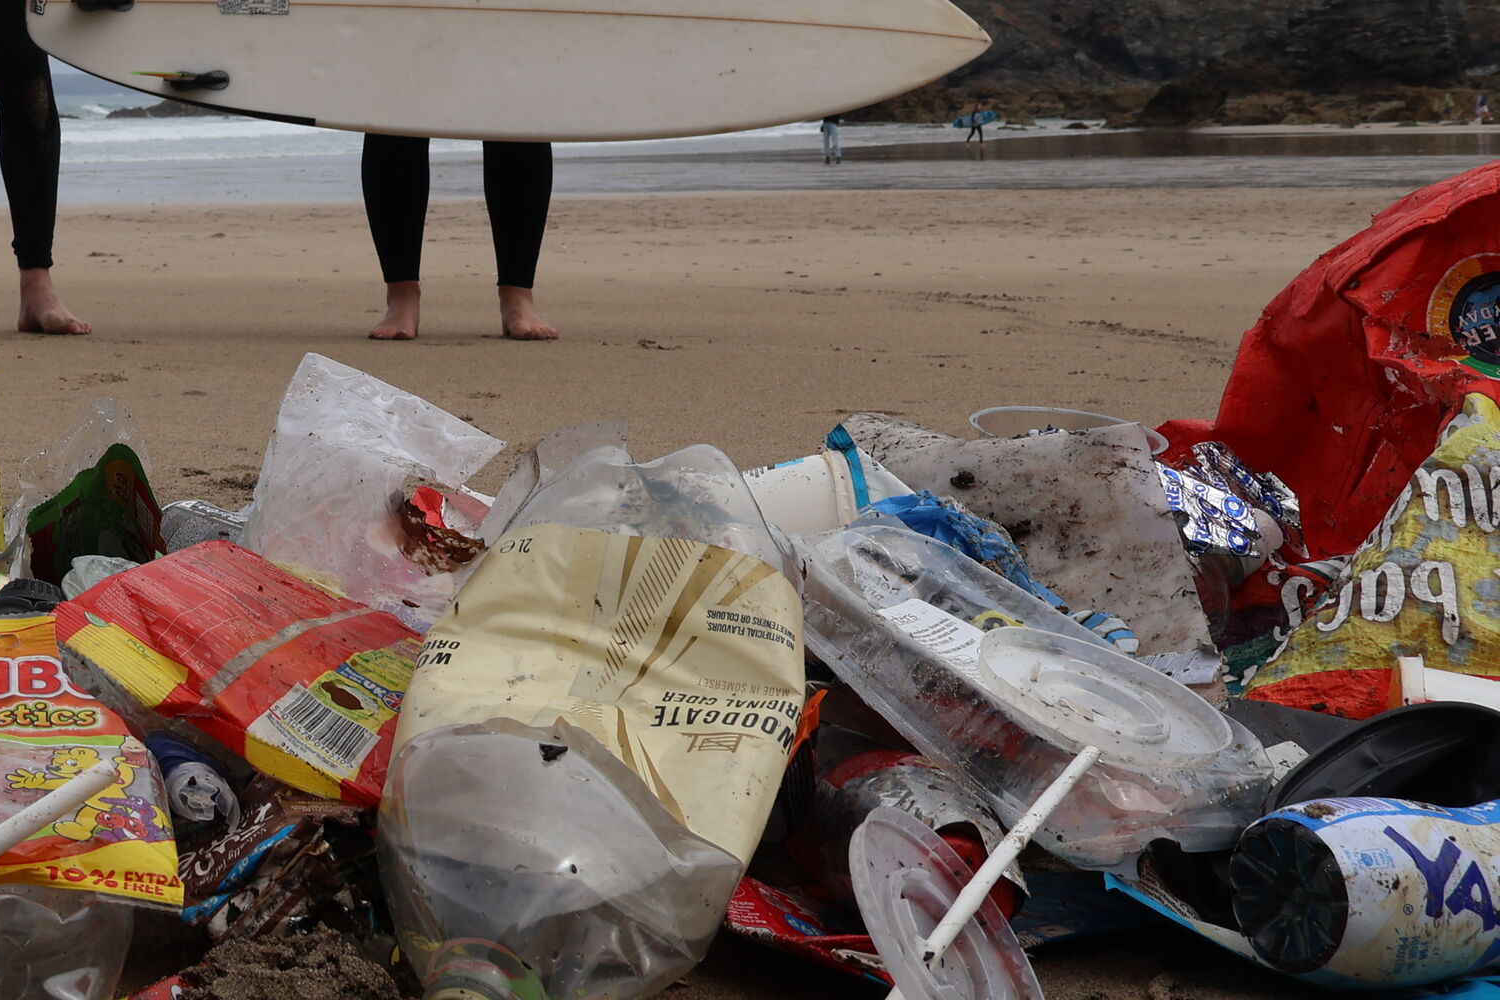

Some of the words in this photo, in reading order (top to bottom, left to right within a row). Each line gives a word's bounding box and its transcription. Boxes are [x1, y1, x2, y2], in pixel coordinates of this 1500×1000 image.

[516, 537, 533, 554] 2L
[707, 609, 740, 623] COLOURS
[740, 613, 752, 624] OR
[746, 626, 786, 645] ARTIFICIAL
[751, 617, 796, 642] SWEETENERS
[786, 640, 795, 651] NO
[362, 679, 387, 698] UK
[697, 677, 747, 693] SOMERSET
[749, 683, 760, 694] IN
[763, 685, 790, 697] MADE
[661, 692, 719, 709] CIDER
[650, 705, 796, 755] WOODGATE
[123, 871, 182, 889] EXTRA
[1383, 825, 1500, 932] YA
[123, 882, 165, 896] FREE
